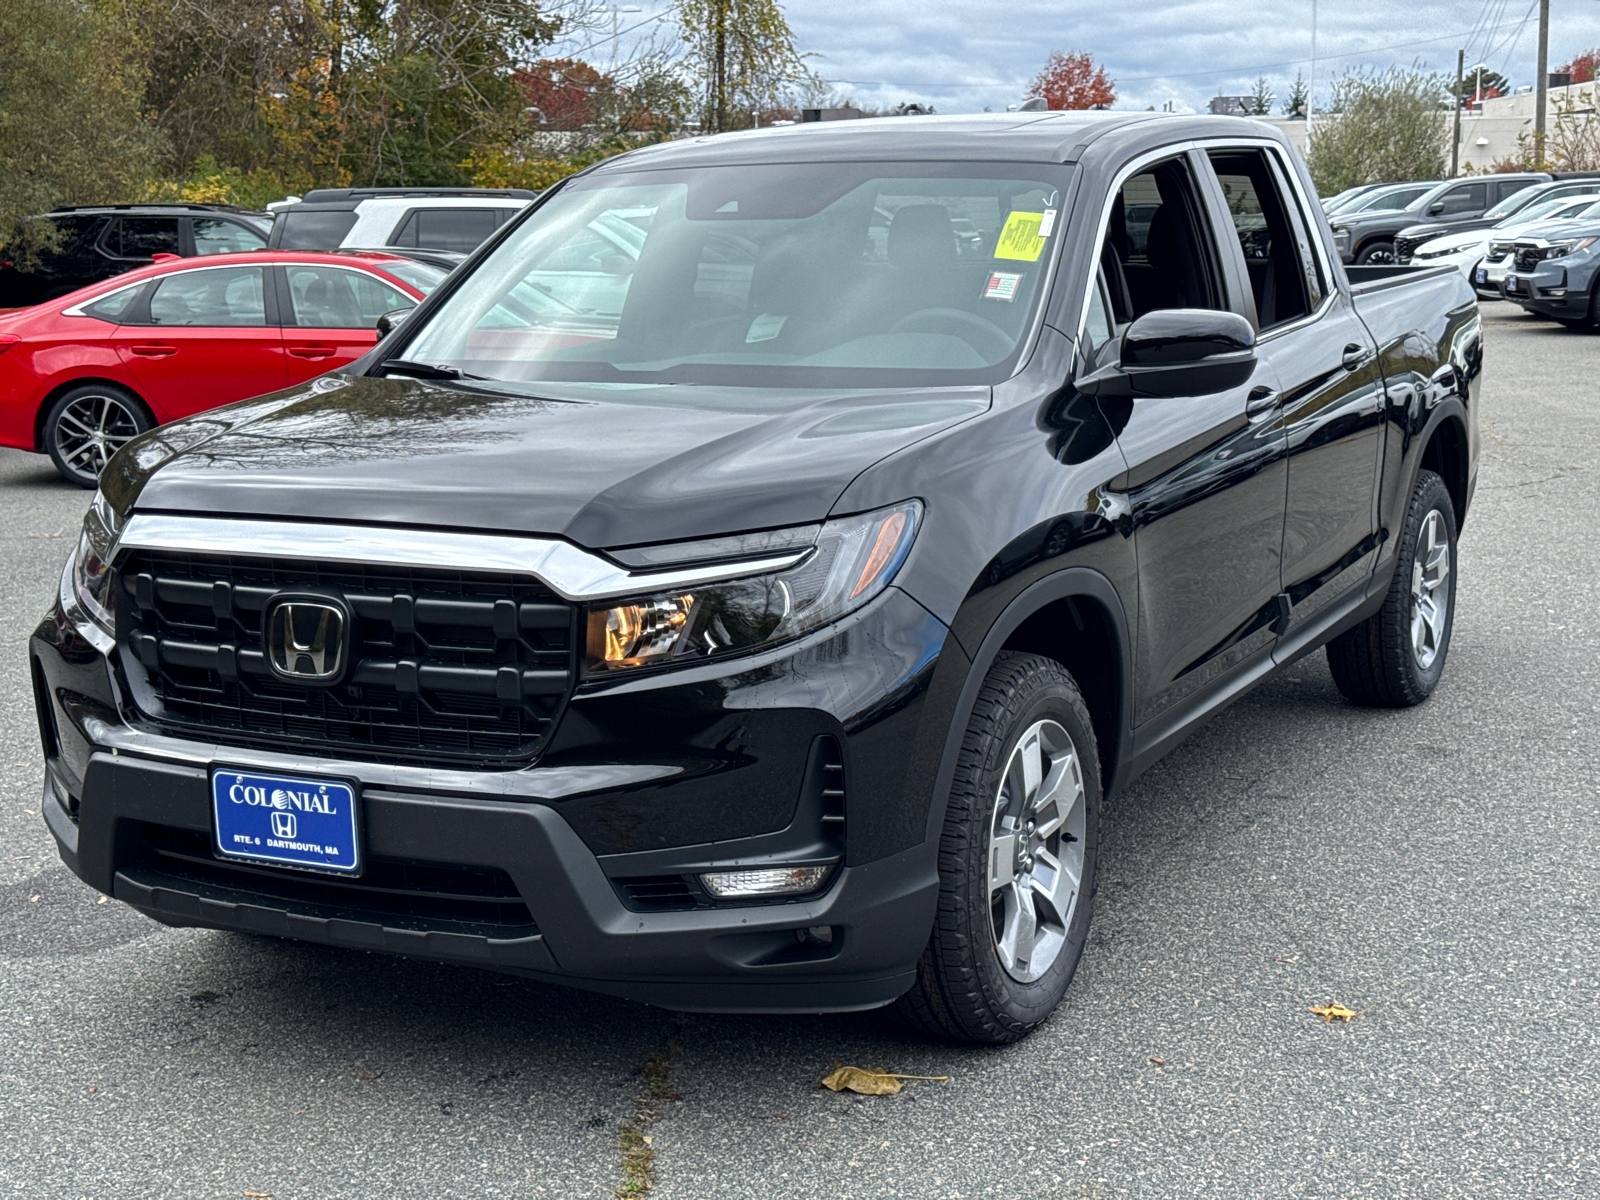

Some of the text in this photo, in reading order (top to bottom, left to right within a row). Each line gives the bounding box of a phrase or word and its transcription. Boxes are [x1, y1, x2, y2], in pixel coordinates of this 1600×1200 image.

[229, 784, 337, 814] COLONIAL
[233, 834, 339, 855] RTE. 6 DARTMOUTH, MA
